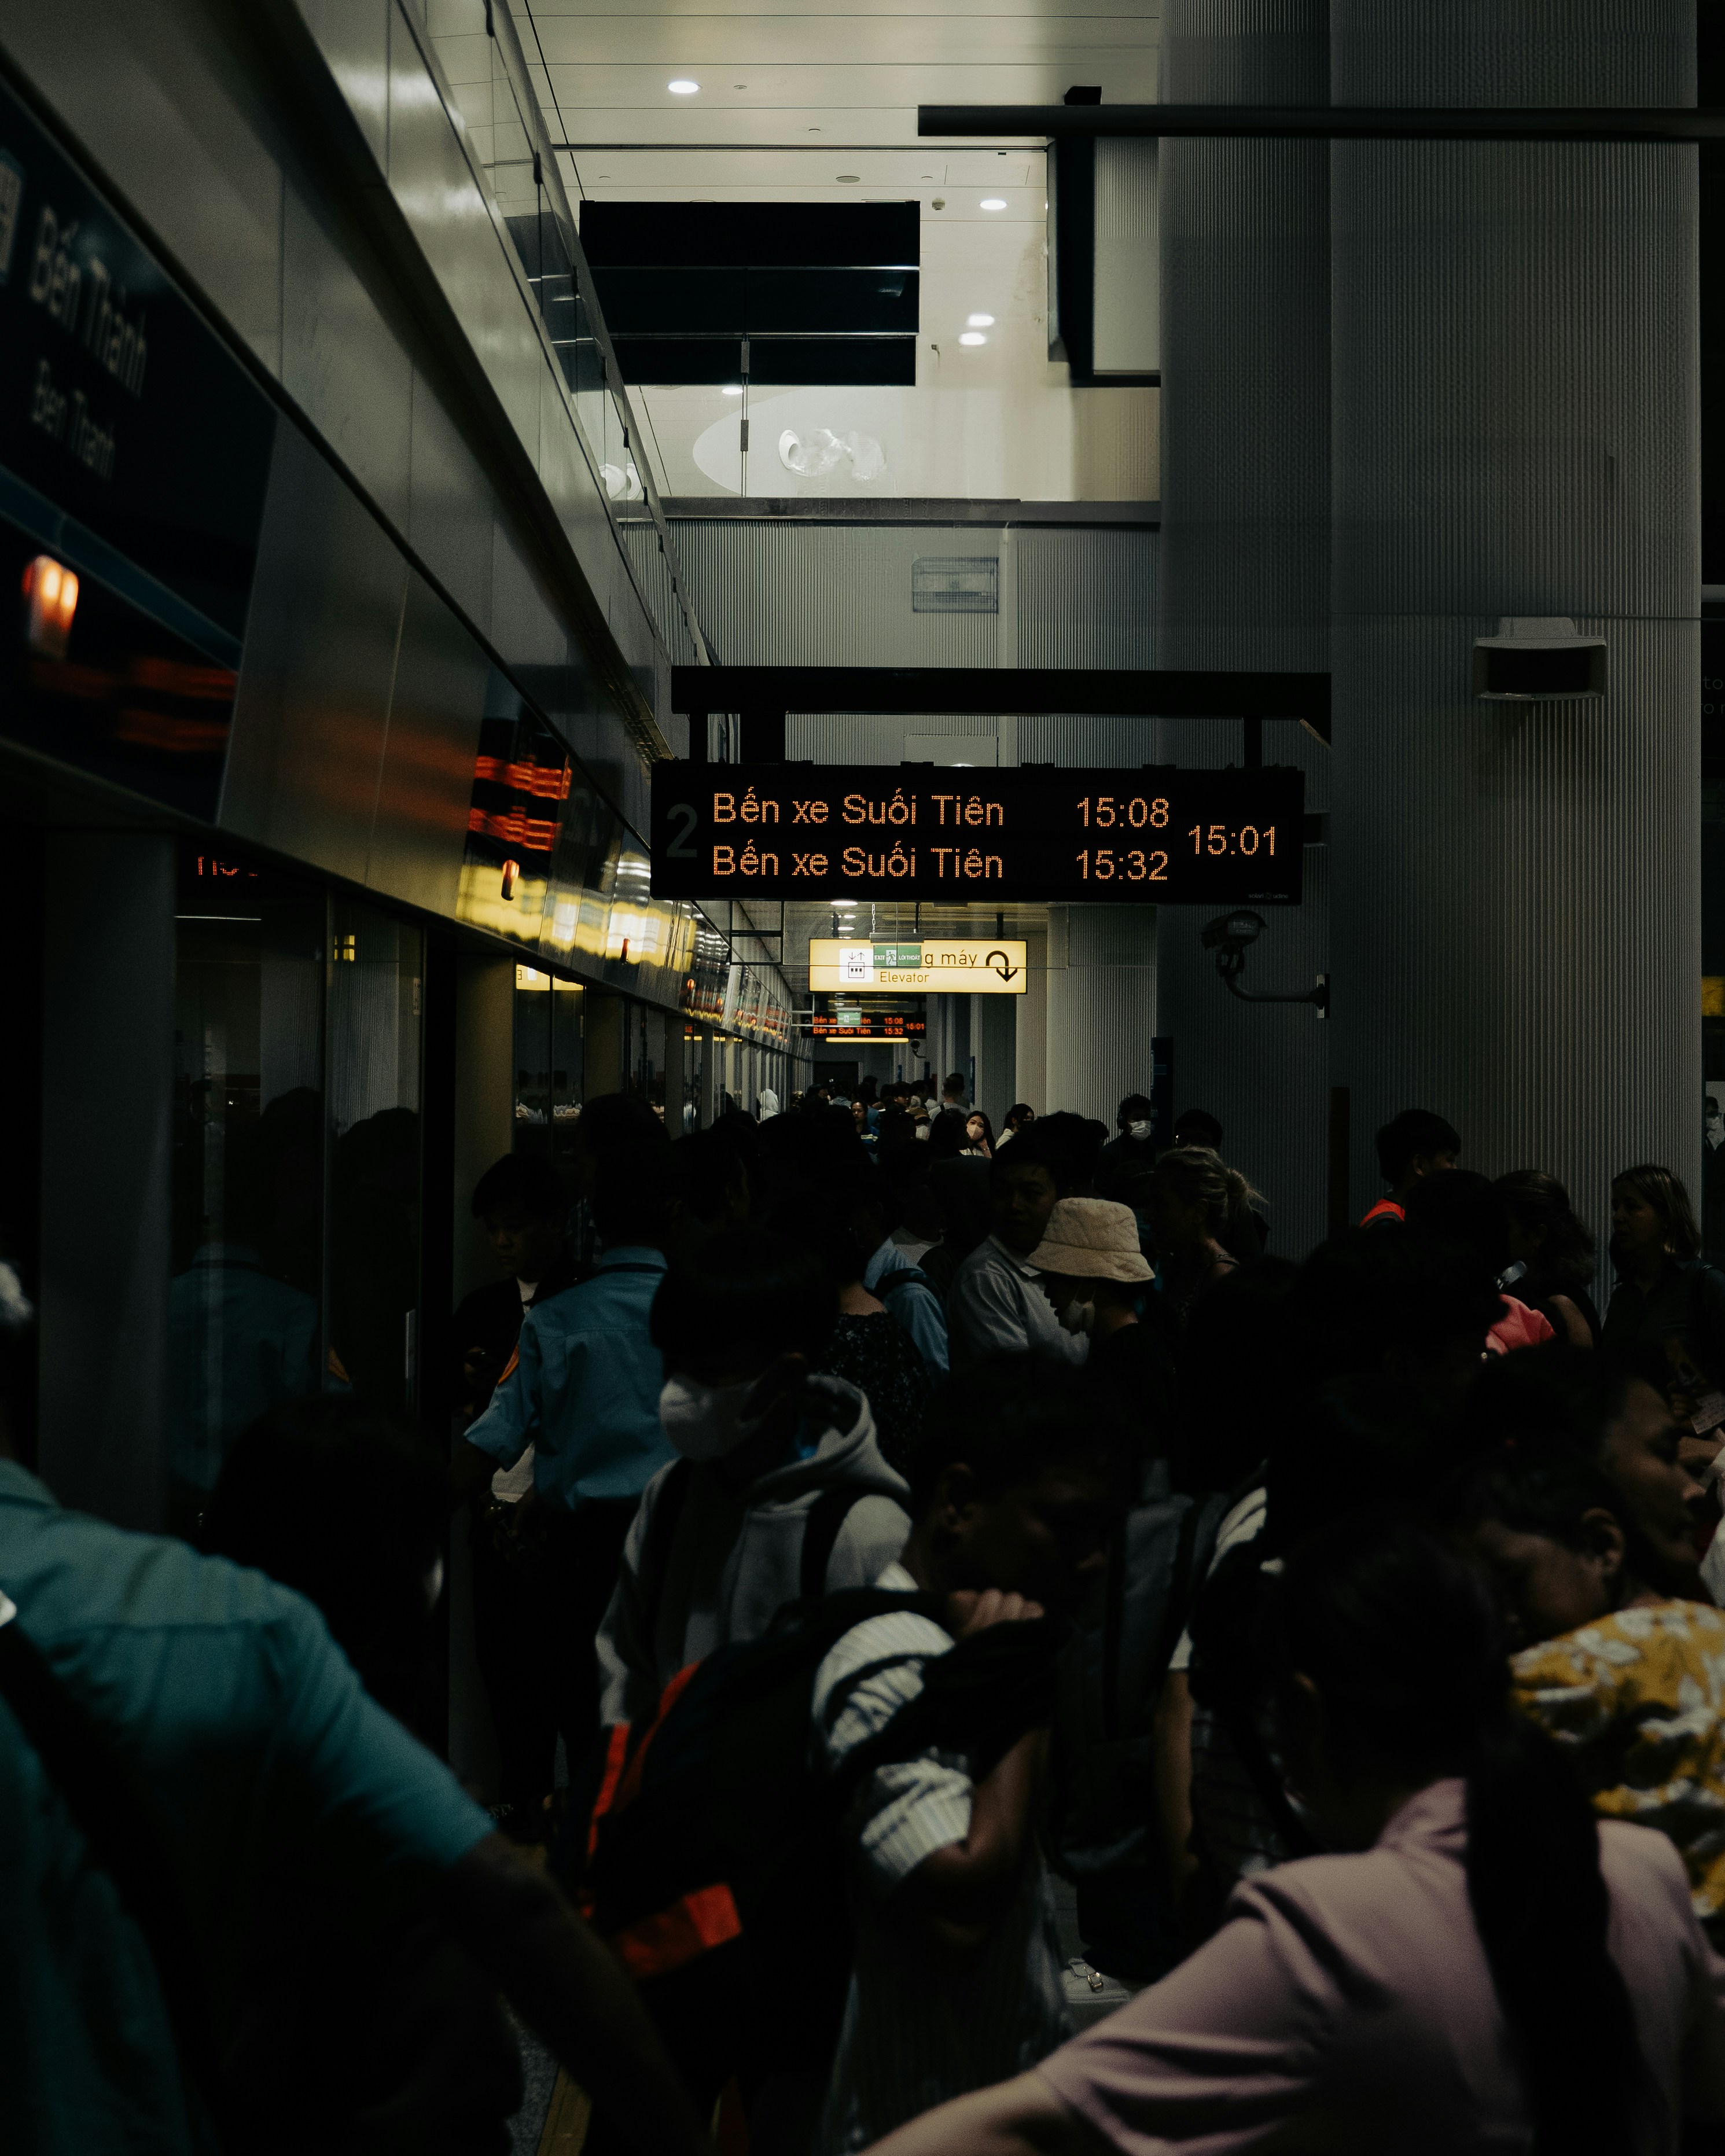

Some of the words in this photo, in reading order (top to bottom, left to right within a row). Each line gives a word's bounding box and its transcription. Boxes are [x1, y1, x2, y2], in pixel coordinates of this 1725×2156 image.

[713, 786, 779, 823] Bến
[792, 801, 829, 823] xe
[842, 788, 916, 825] Suối
[931, 795, 1003, 826] Tiên
[1077, 797, 1169, 827] 15:08
[665, 803, 698, 858] 2
[1189, 825, 1278, 856] 15:01
[713, 839, 778, 875] Bến
[792, 853, 828, 876] xe
[841, 840, 915, 877] Suối
[930, 848, 1002, 878] Tiên
[1076, 850, 1168, 880] 15:32
[880, 972, 929, 983] Elevator
[941, 950, 977, 969] máy
